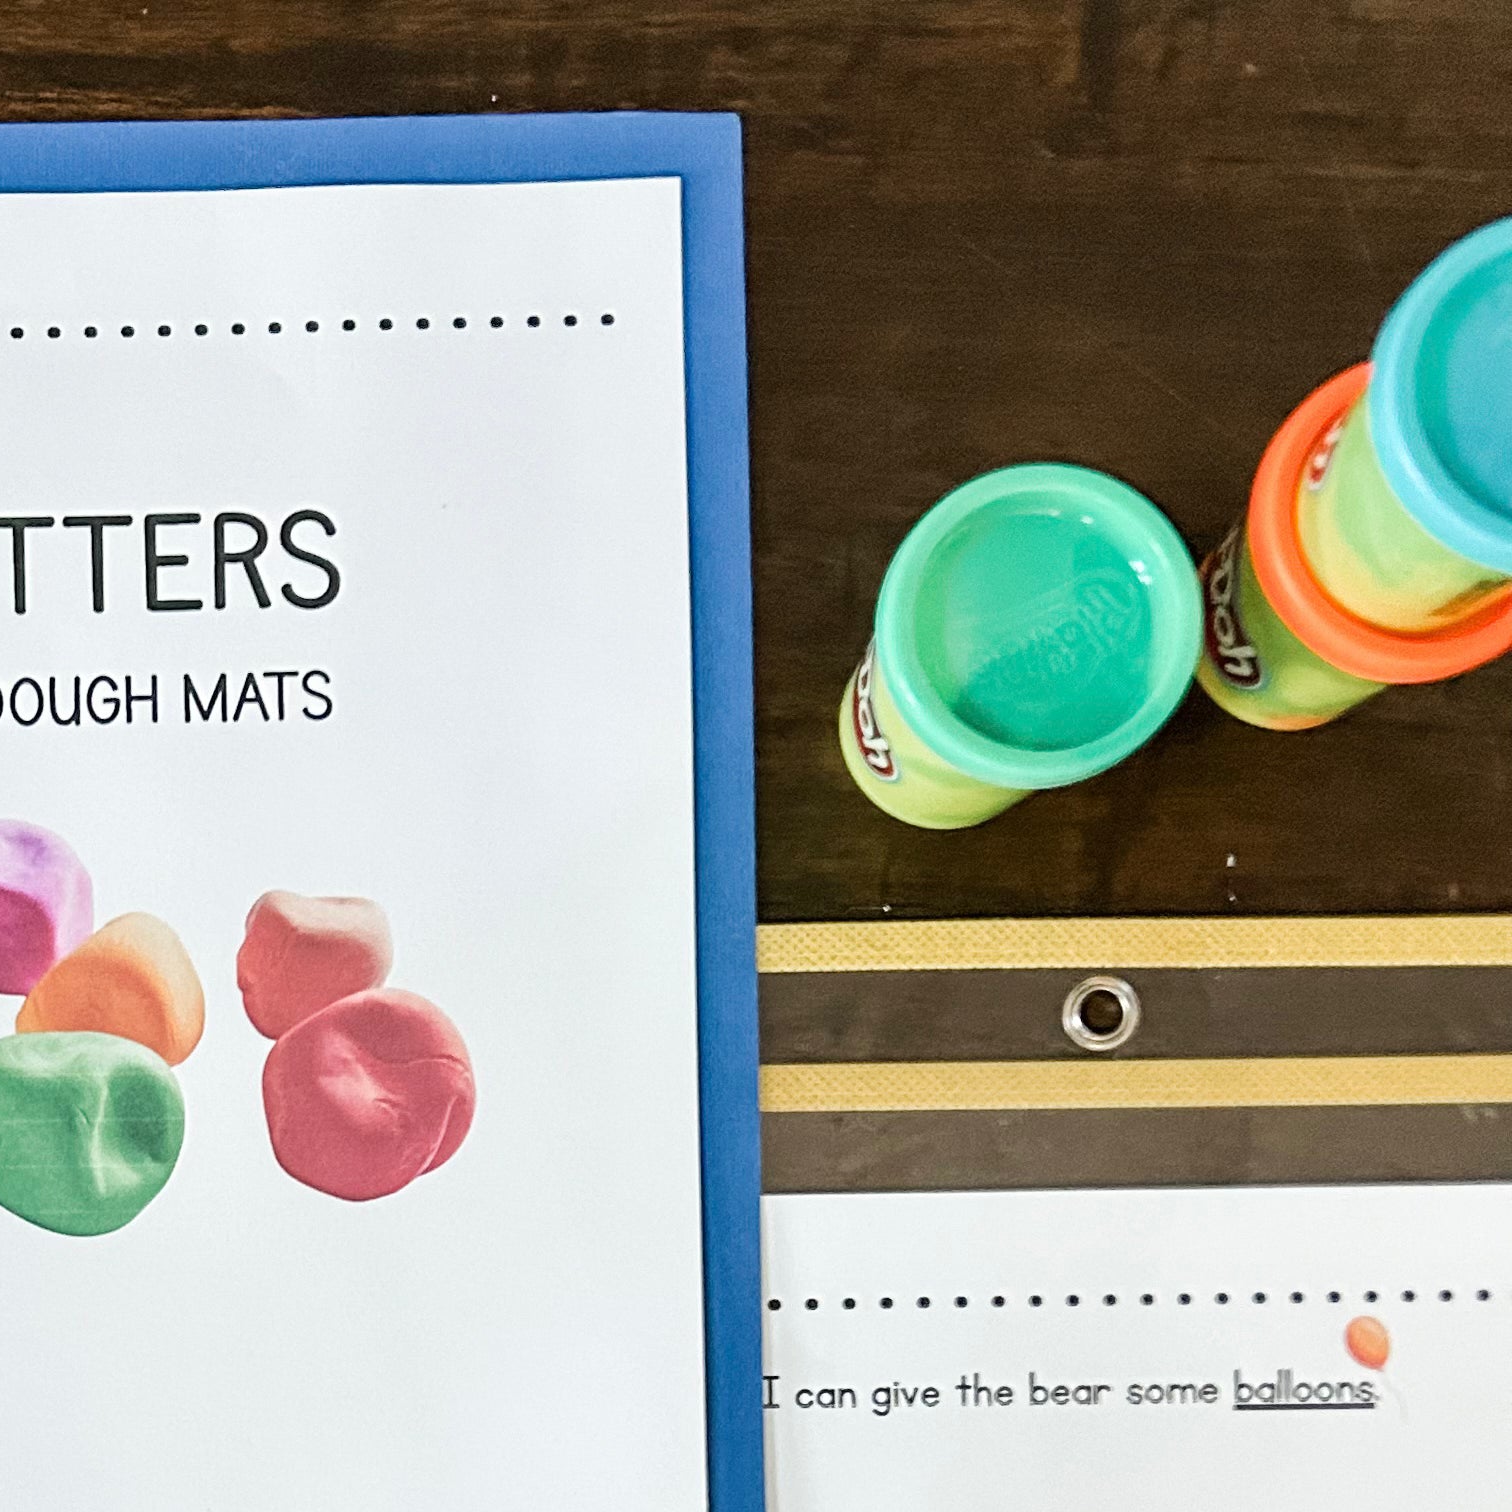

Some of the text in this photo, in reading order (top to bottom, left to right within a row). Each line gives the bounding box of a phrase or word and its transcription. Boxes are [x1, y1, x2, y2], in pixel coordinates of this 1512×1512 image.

[182, 669, 334, 724] MATS
[763, 1375, 780, 1409] I
[794, 1388, 857, 1409] can
[871, 1380, 940, 1416] give
[955, 1372, 1015, 1407] the
[1028, 1371, 1113, 1406] bear
[1126, 1383, 1220, 1405] some
